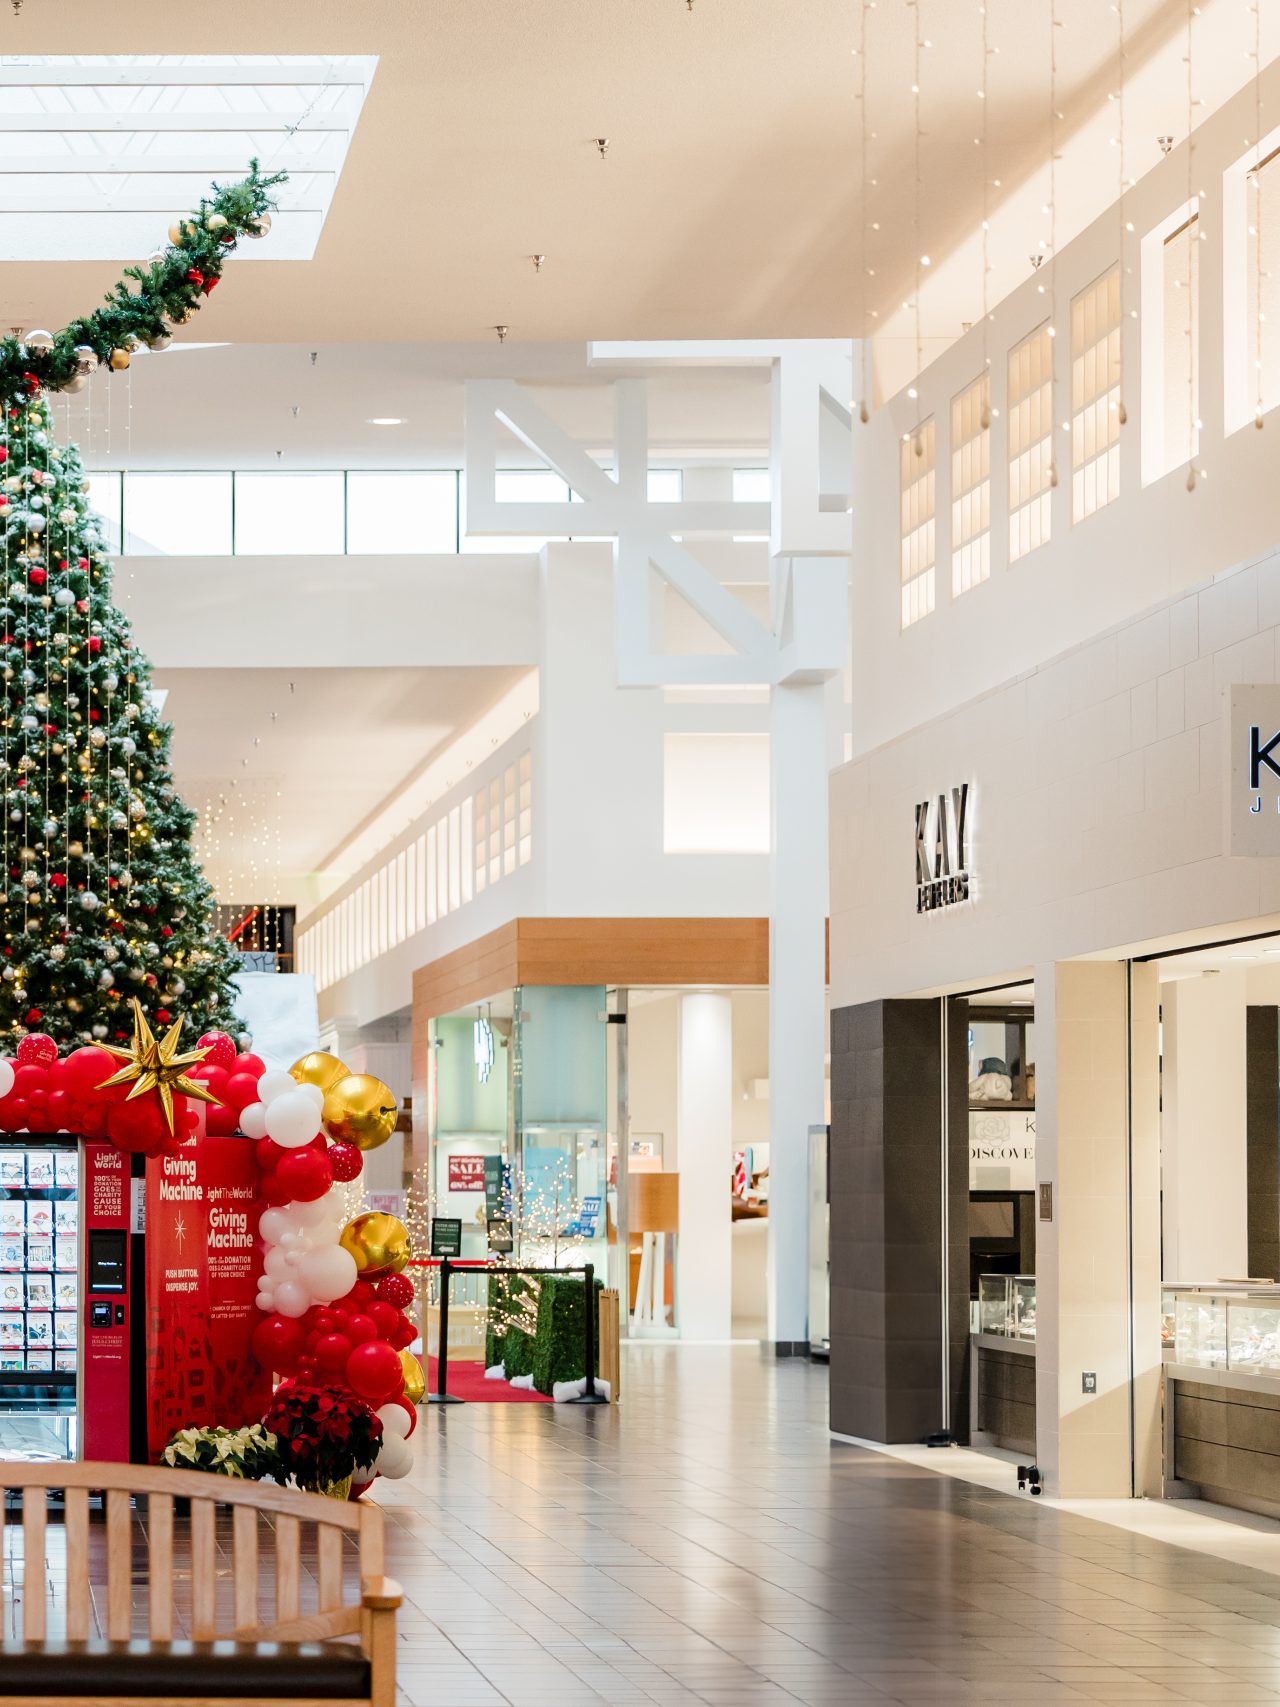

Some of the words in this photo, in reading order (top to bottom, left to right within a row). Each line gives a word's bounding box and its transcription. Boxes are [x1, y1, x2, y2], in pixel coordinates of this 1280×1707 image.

[915, 784, 968, 884] KAY
[94, 1160, 122, 1168] World
[96, 1153, 118, 1162] Light
[163, 1154, 197, 1182] Giving
[450, 1165, 485, 1174] SALE
[160, 1179, 203, 1200] Machine
[209, 1207, 247, 1233] Giving
[208, 1228, 254, 1248] Machine
[165, 1269, 178, 1278] PUSH
[165, 1282, 189, 1292] DISPENSE
